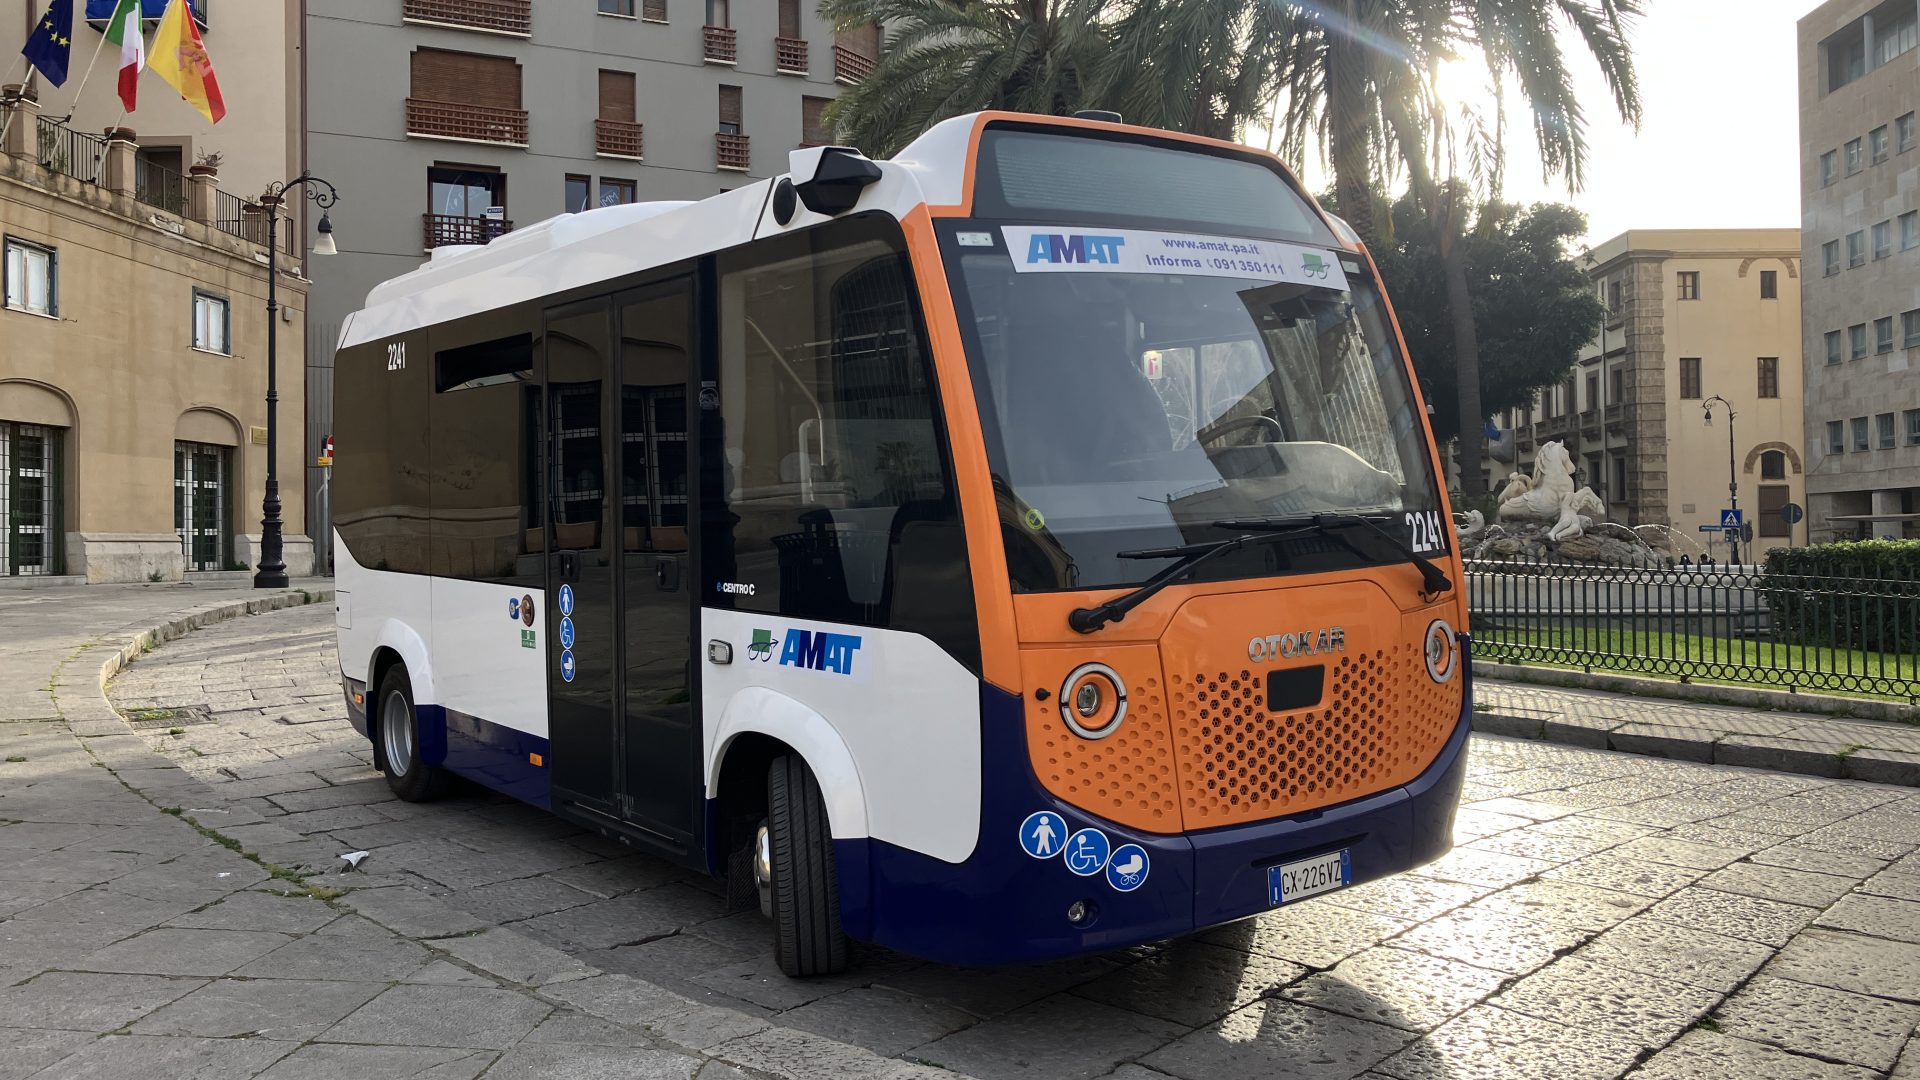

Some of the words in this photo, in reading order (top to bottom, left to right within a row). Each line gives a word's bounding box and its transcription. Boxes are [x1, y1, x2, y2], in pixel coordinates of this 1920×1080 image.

[1026, 234, 1125, 264] AMAT
[1145, 254, 1202, 268] Informa
[1162, 238, 1260, 255] www.amat.pa.it
[387, 341, 406, 371] 2241
[1405, 510, 1446, 553] 2241
[779, 628, 862, 675] AMAT
[1248, 626, 1345, 663] OTOKAR
